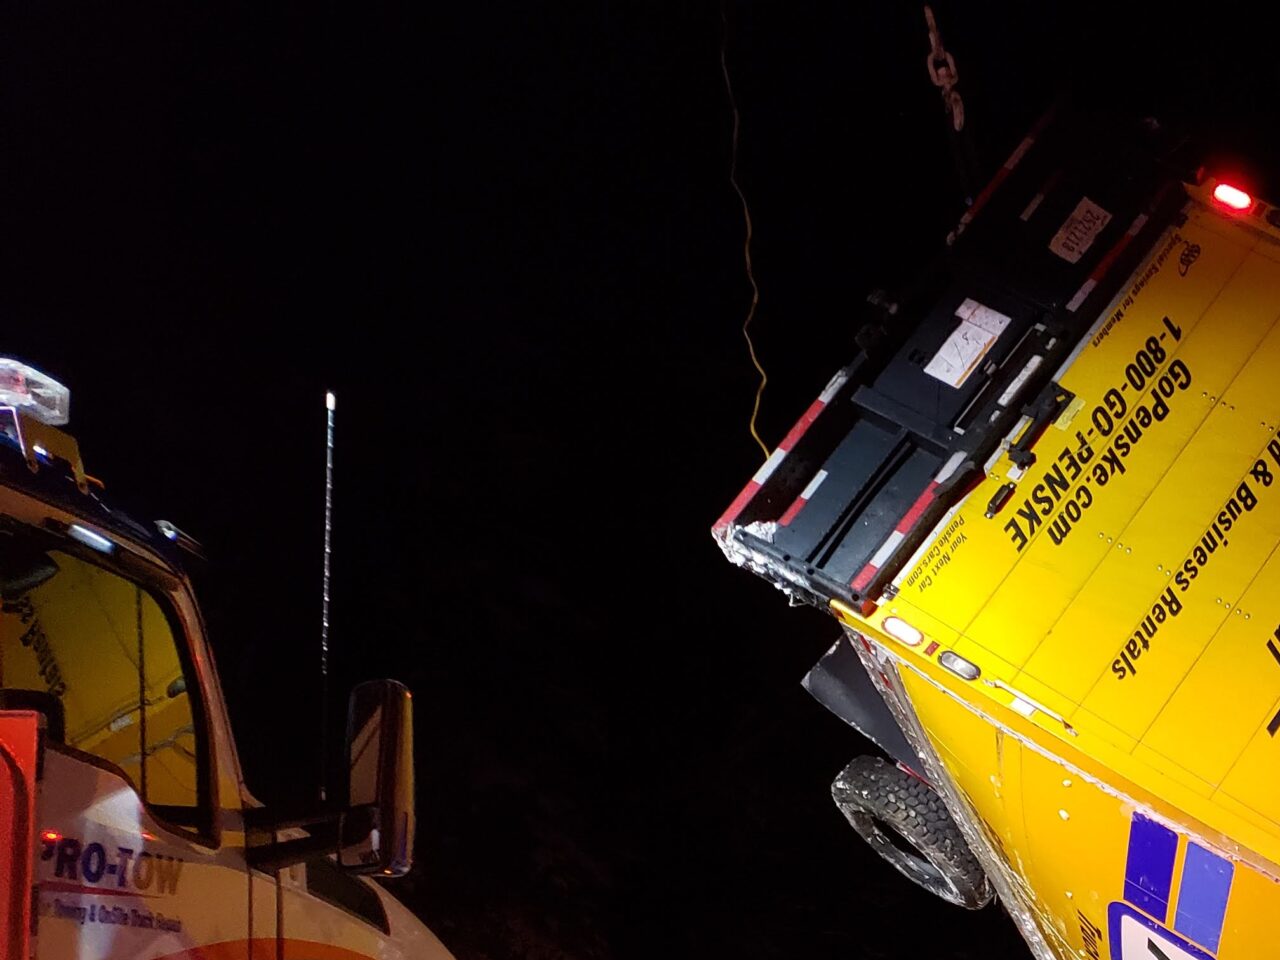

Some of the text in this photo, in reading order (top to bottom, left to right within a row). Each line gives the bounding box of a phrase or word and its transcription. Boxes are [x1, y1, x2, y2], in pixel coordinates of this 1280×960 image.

[1092, 307, 1125, 348] Members
[1003, 315, 1183, 553] 1-800-GO-PENSKE
[1046, 358, 1192, 546] GoPenske.com
[1250, 458, 1274, 487] &
[918, 532, 968, 593] Your Next Car
[1174, 481, 1258, 592] Business
[1111, 586, 1184, 680] Rentals
